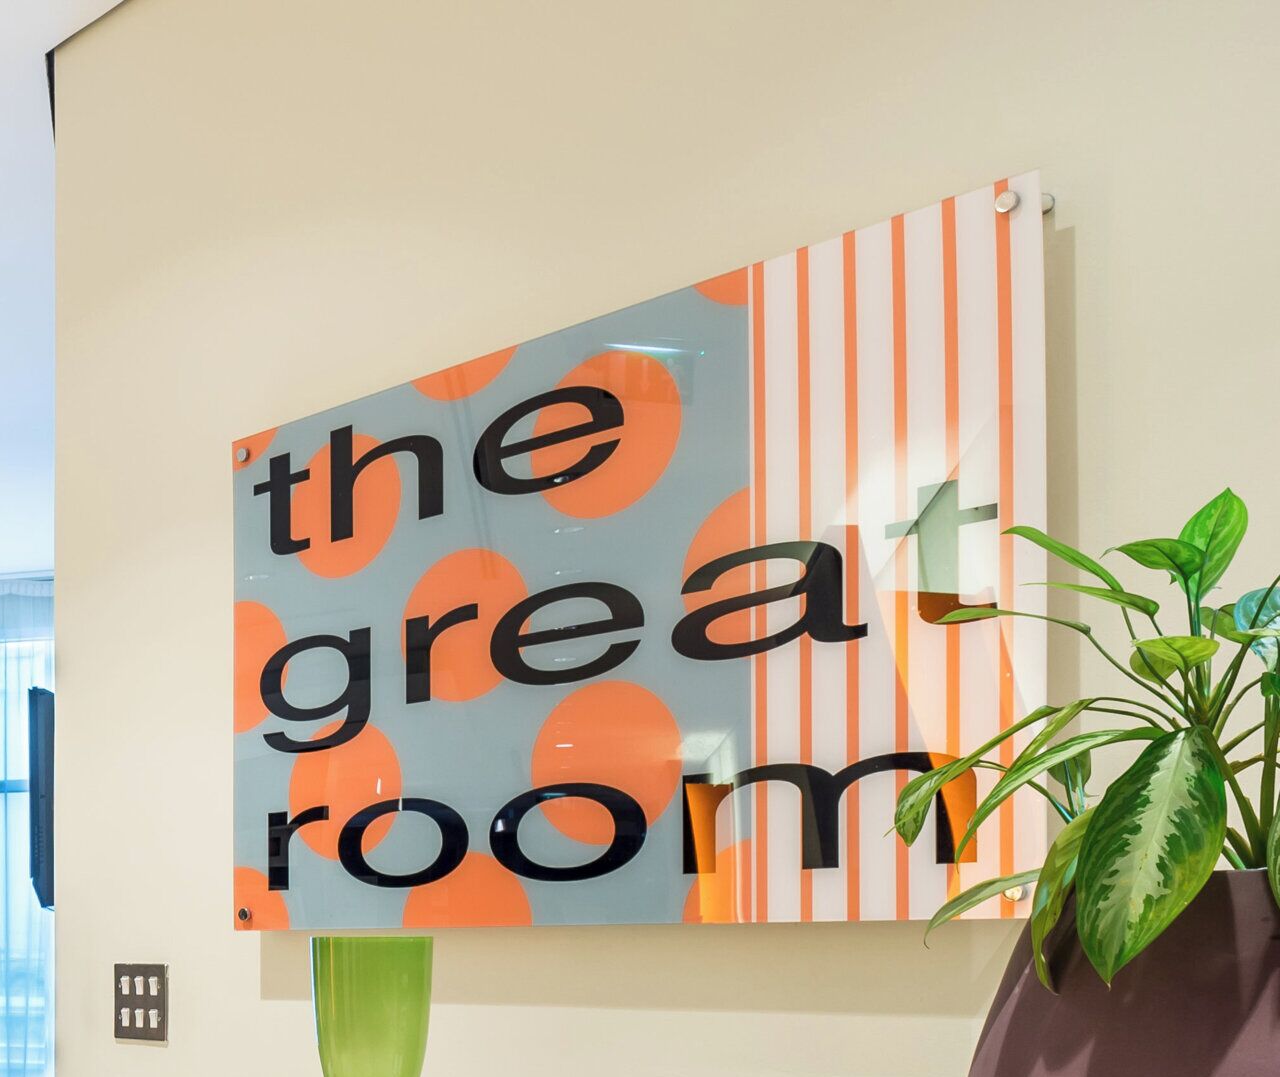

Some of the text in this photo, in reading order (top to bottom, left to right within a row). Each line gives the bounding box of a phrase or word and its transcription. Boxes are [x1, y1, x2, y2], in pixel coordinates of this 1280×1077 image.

[253, 385, 625, 556] the
[258, 479, 1000, 755] great
[266, 751, 978, 892] room
